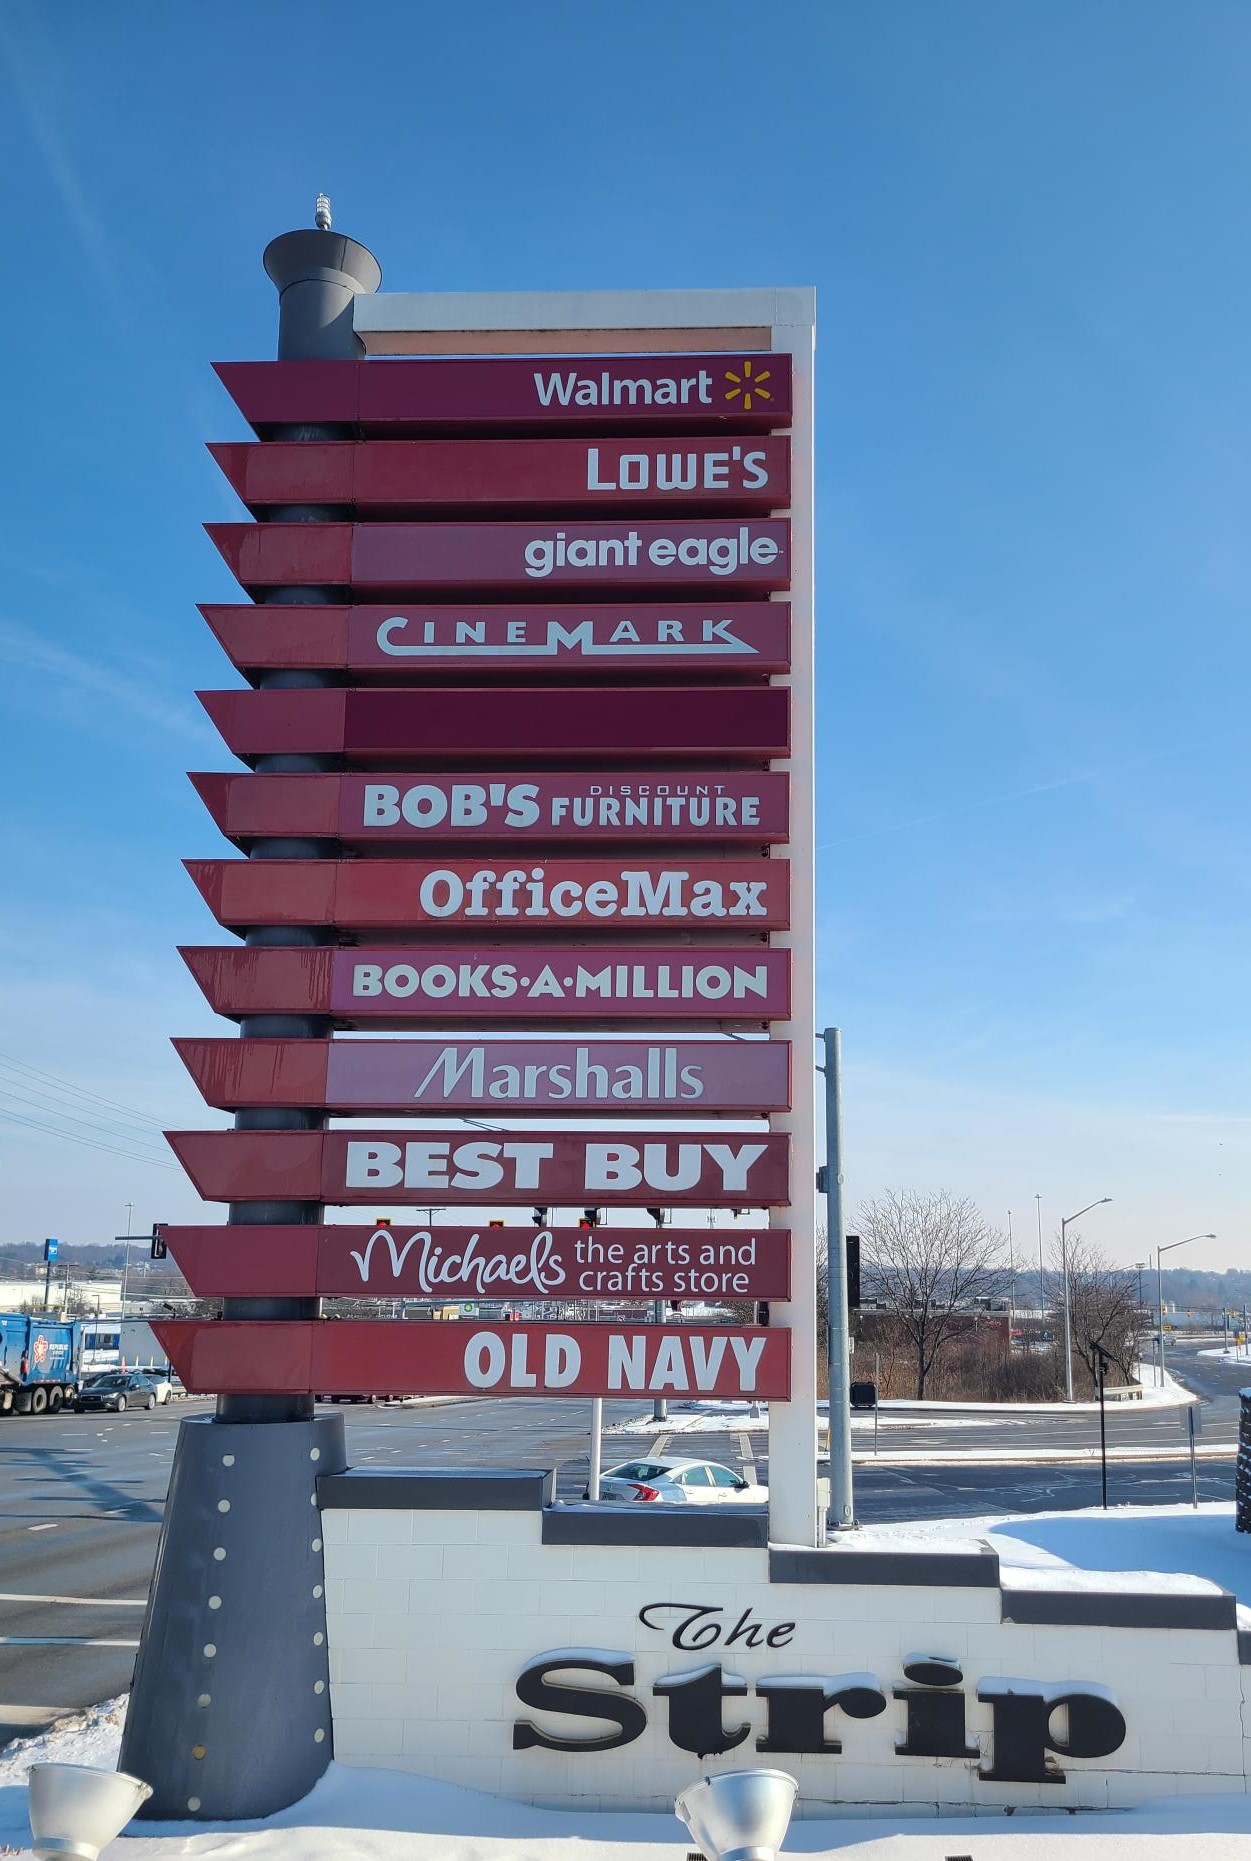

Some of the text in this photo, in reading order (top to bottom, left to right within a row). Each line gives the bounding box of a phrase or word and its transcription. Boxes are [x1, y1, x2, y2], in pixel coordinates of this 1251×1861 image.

[534, 371, 713, 406] Walmart
[587, 447, 769, 491] LOWE'S
[524, 527, 779, 578] giant eagle
[363, 783, 540, 829] BOB'S
[551, 797, 761, 827] FURNITURE
[590, 785, 726, 796] DISCOUNT
[419, 868, 768, 918] OfficeMax
[413, 1047, 705, 1099] Marshalls
[345, 1141, 769, 1192] BEST BUY
[350, 1229, 567, 1294] Michaels
[574, 1236, 756, 1265] the arts and
[578, 1262, 749, 1293] crafts store
[464, 1331, 767, 1392] OLD NAVY
[639, 1602, 796, 1651] The
[512, 1653, 1127, 1783] Strip
